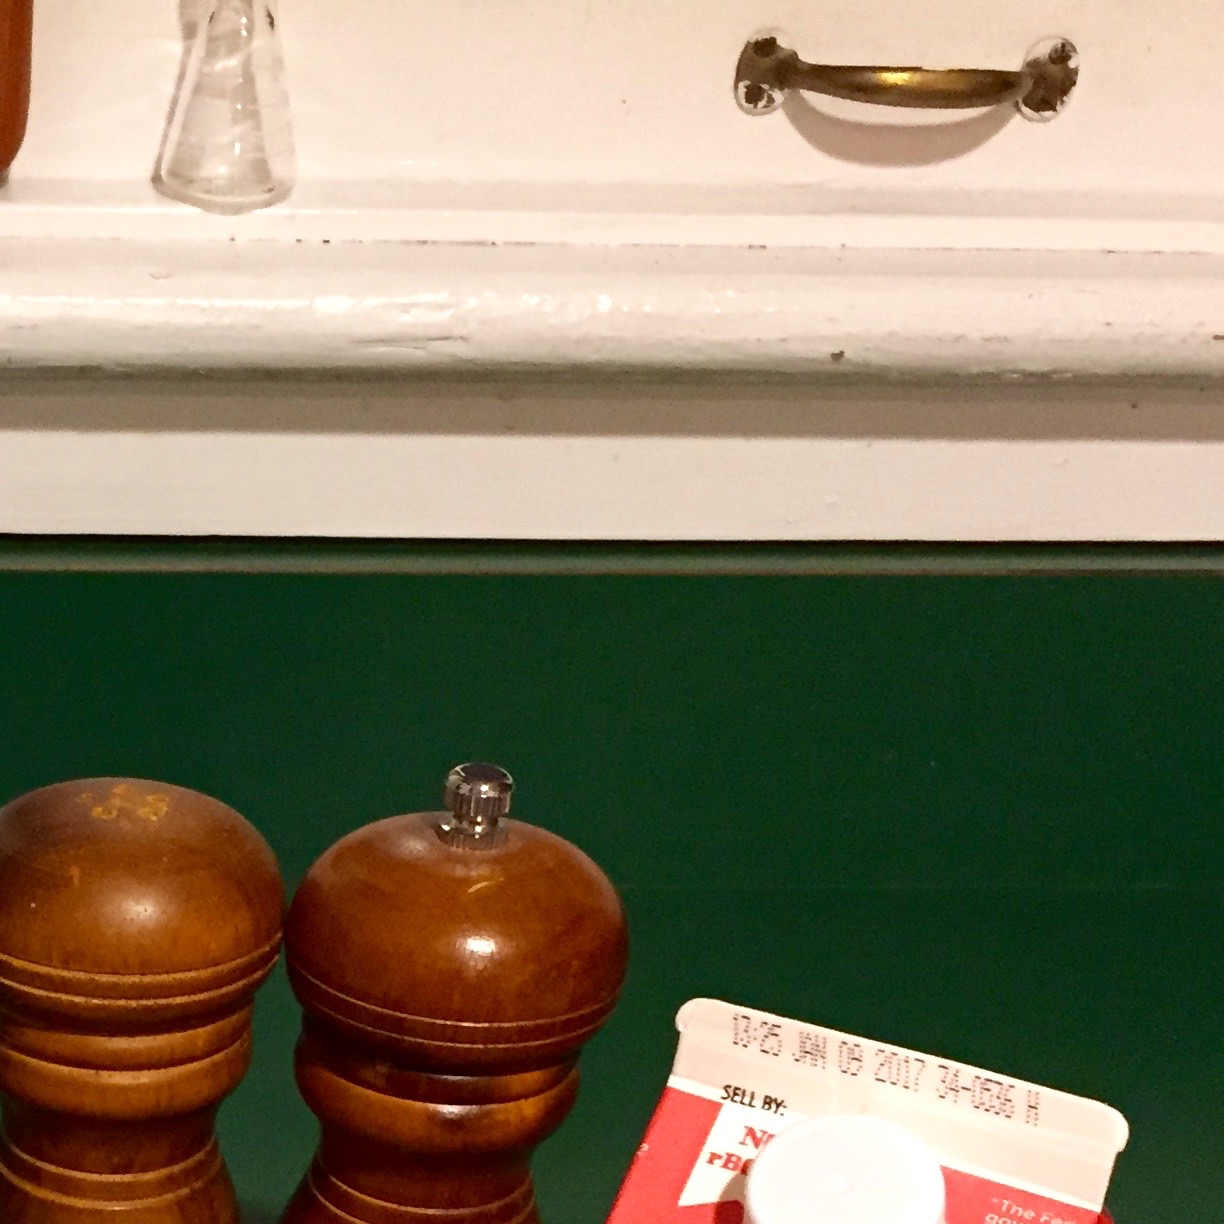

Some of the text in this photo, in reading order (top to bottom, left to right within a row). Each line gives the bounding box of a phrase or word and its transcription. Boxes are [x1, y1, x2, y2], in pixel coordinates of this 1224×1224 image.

[791, 1031, 827, 1070] JAN
[874, 1048, 926, 1092] 2017
[720, 1084, 757, 1109] SELL
[738, 1125, 776, 1149] N
